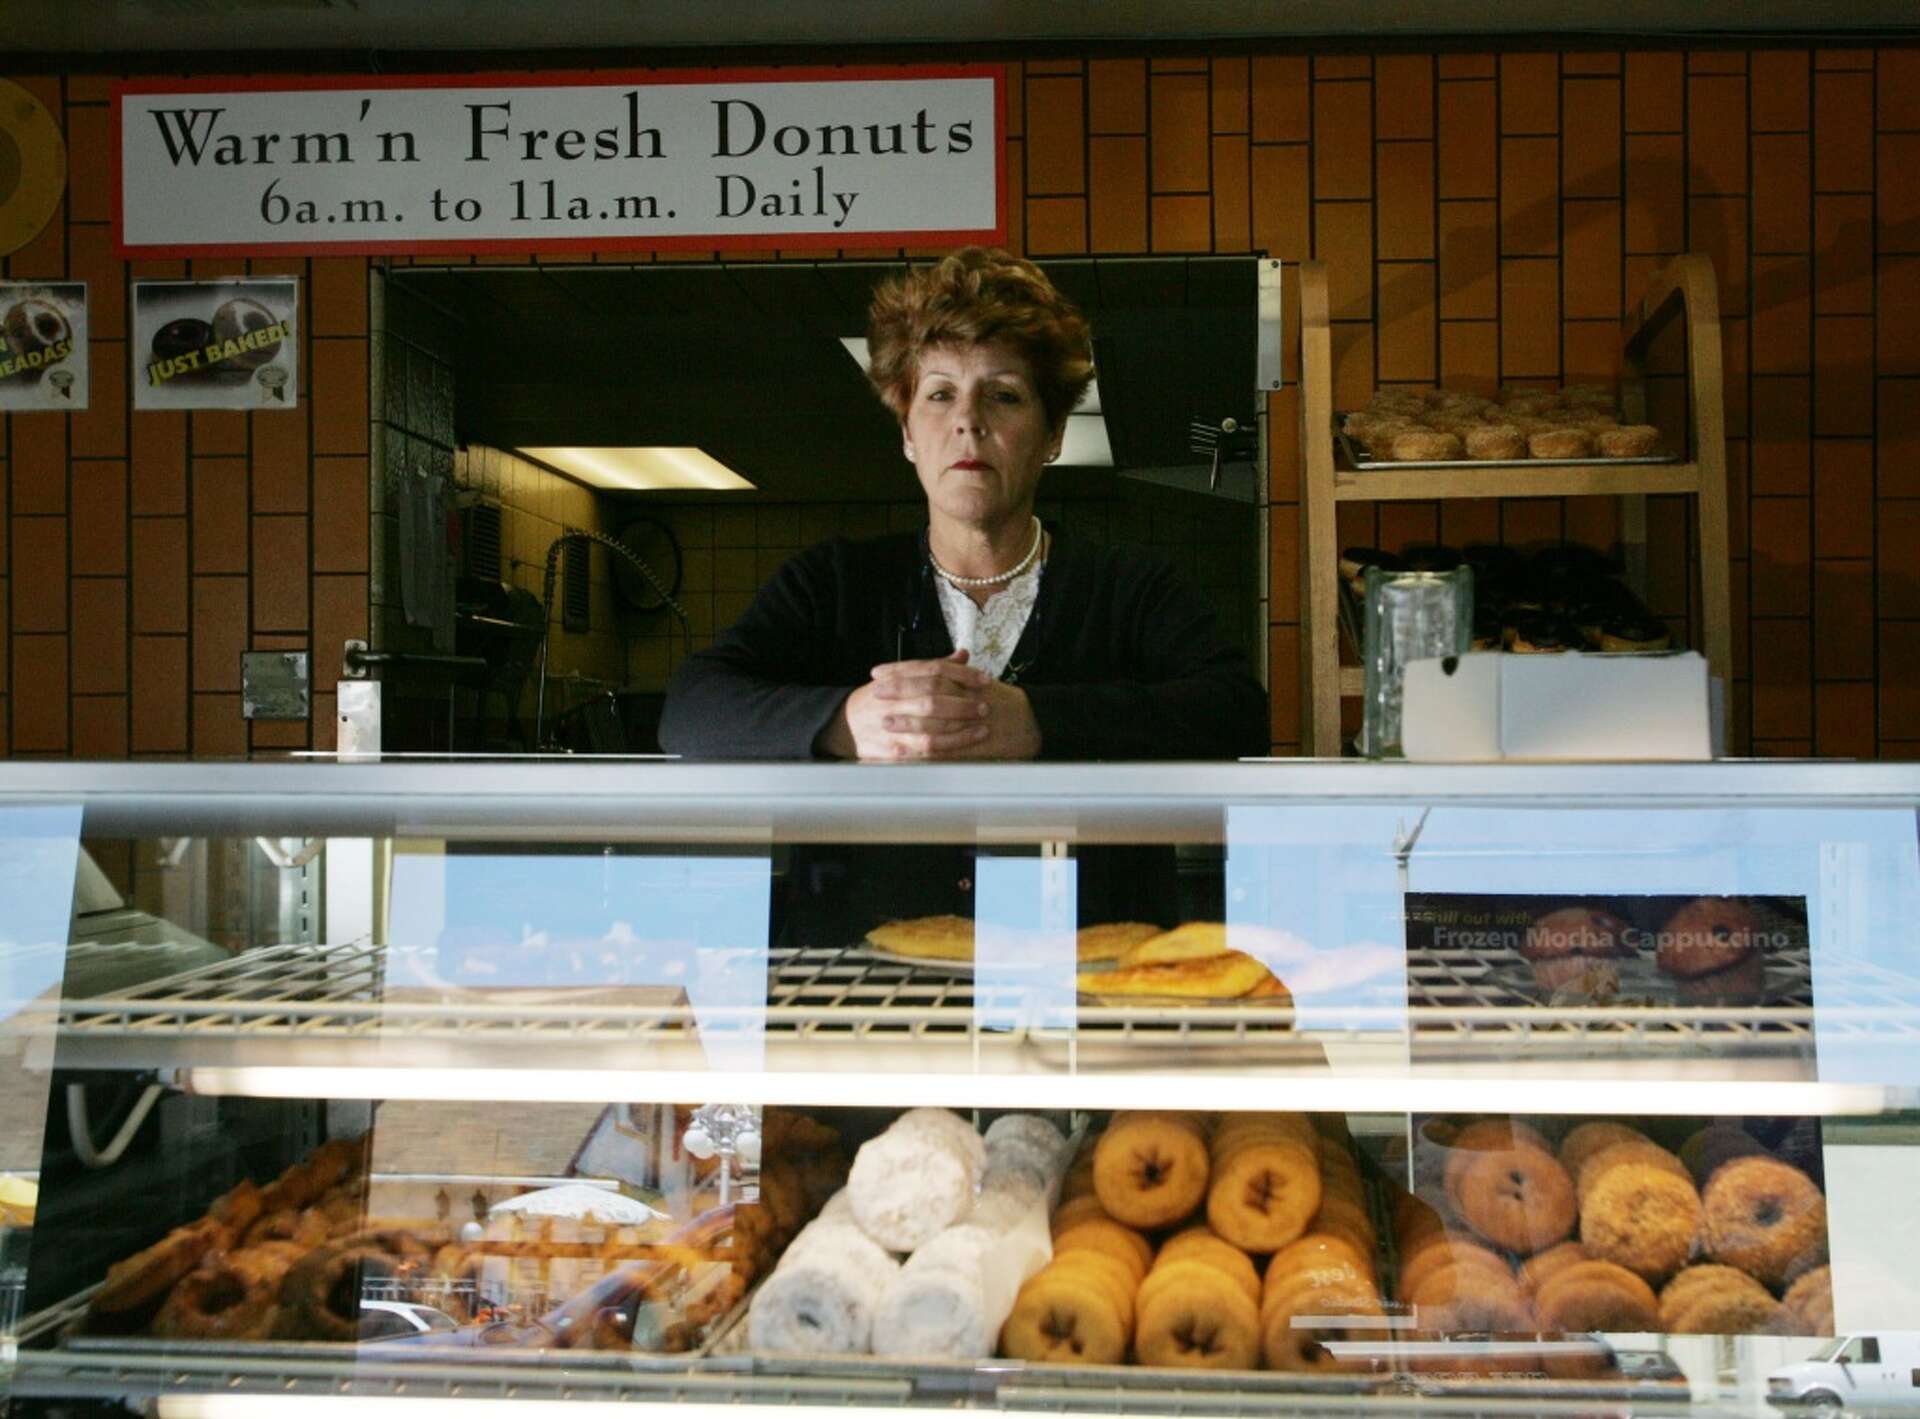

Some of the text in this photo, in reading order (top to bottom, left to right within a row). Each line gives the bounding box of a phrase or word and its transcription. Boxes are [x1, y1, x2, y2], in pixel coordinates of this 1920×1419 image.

[147, 91, 974, 167] Warm'n Fresh Donuts
[259, 165, 860, 228] 6a.m. to 11a.m. Daily
[148, 320, 291, 389] JUST BAKED!
[1433, 925, 1790, 953] Frozen Mocha Cappuccino
[1463, 912, 1490, 926] out
